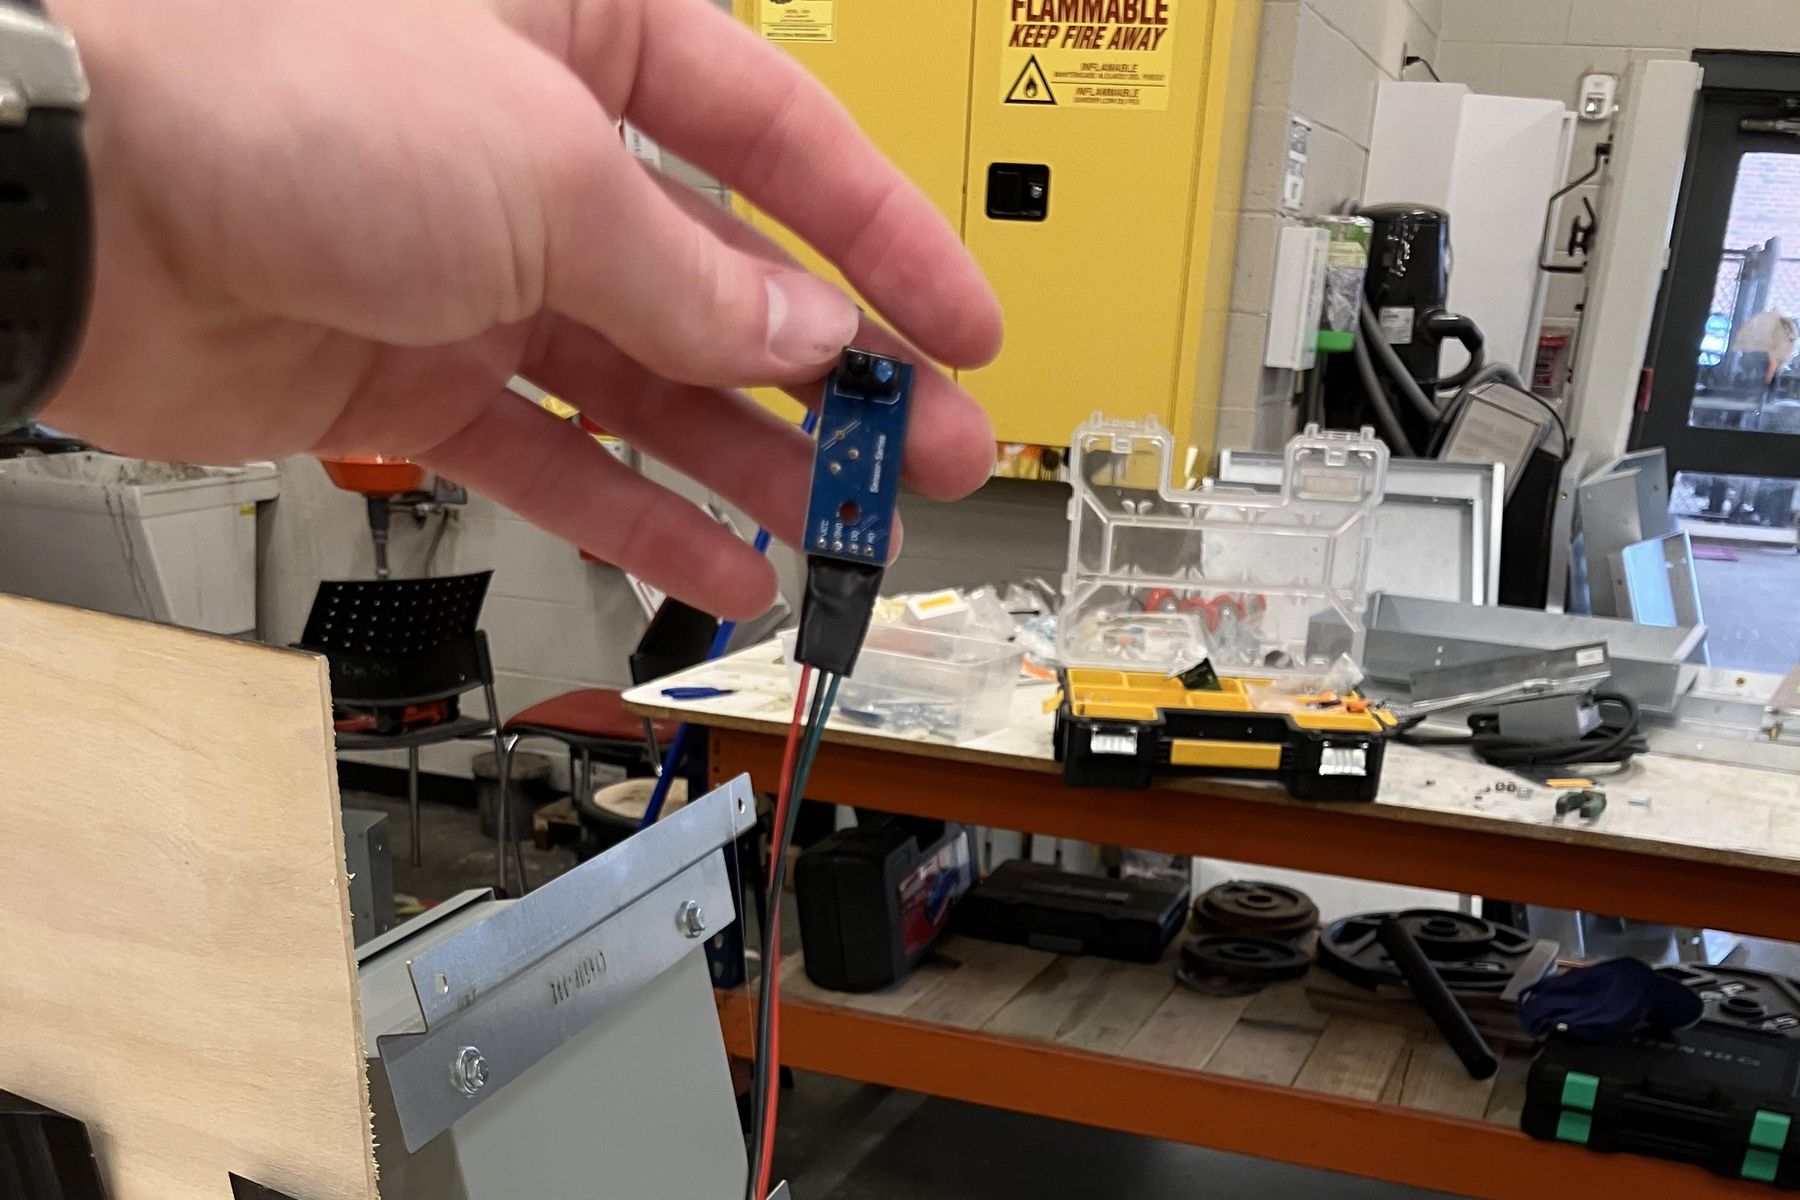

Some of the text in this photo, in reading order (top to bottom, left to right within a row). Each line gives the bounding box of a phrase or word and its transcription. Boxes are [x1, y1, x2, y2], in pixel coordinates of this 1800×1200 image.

[1011, 0, 1169, 25] FLAMMABLE
[1009, 24, 1167, 51] KEEP FIRE AWAY
